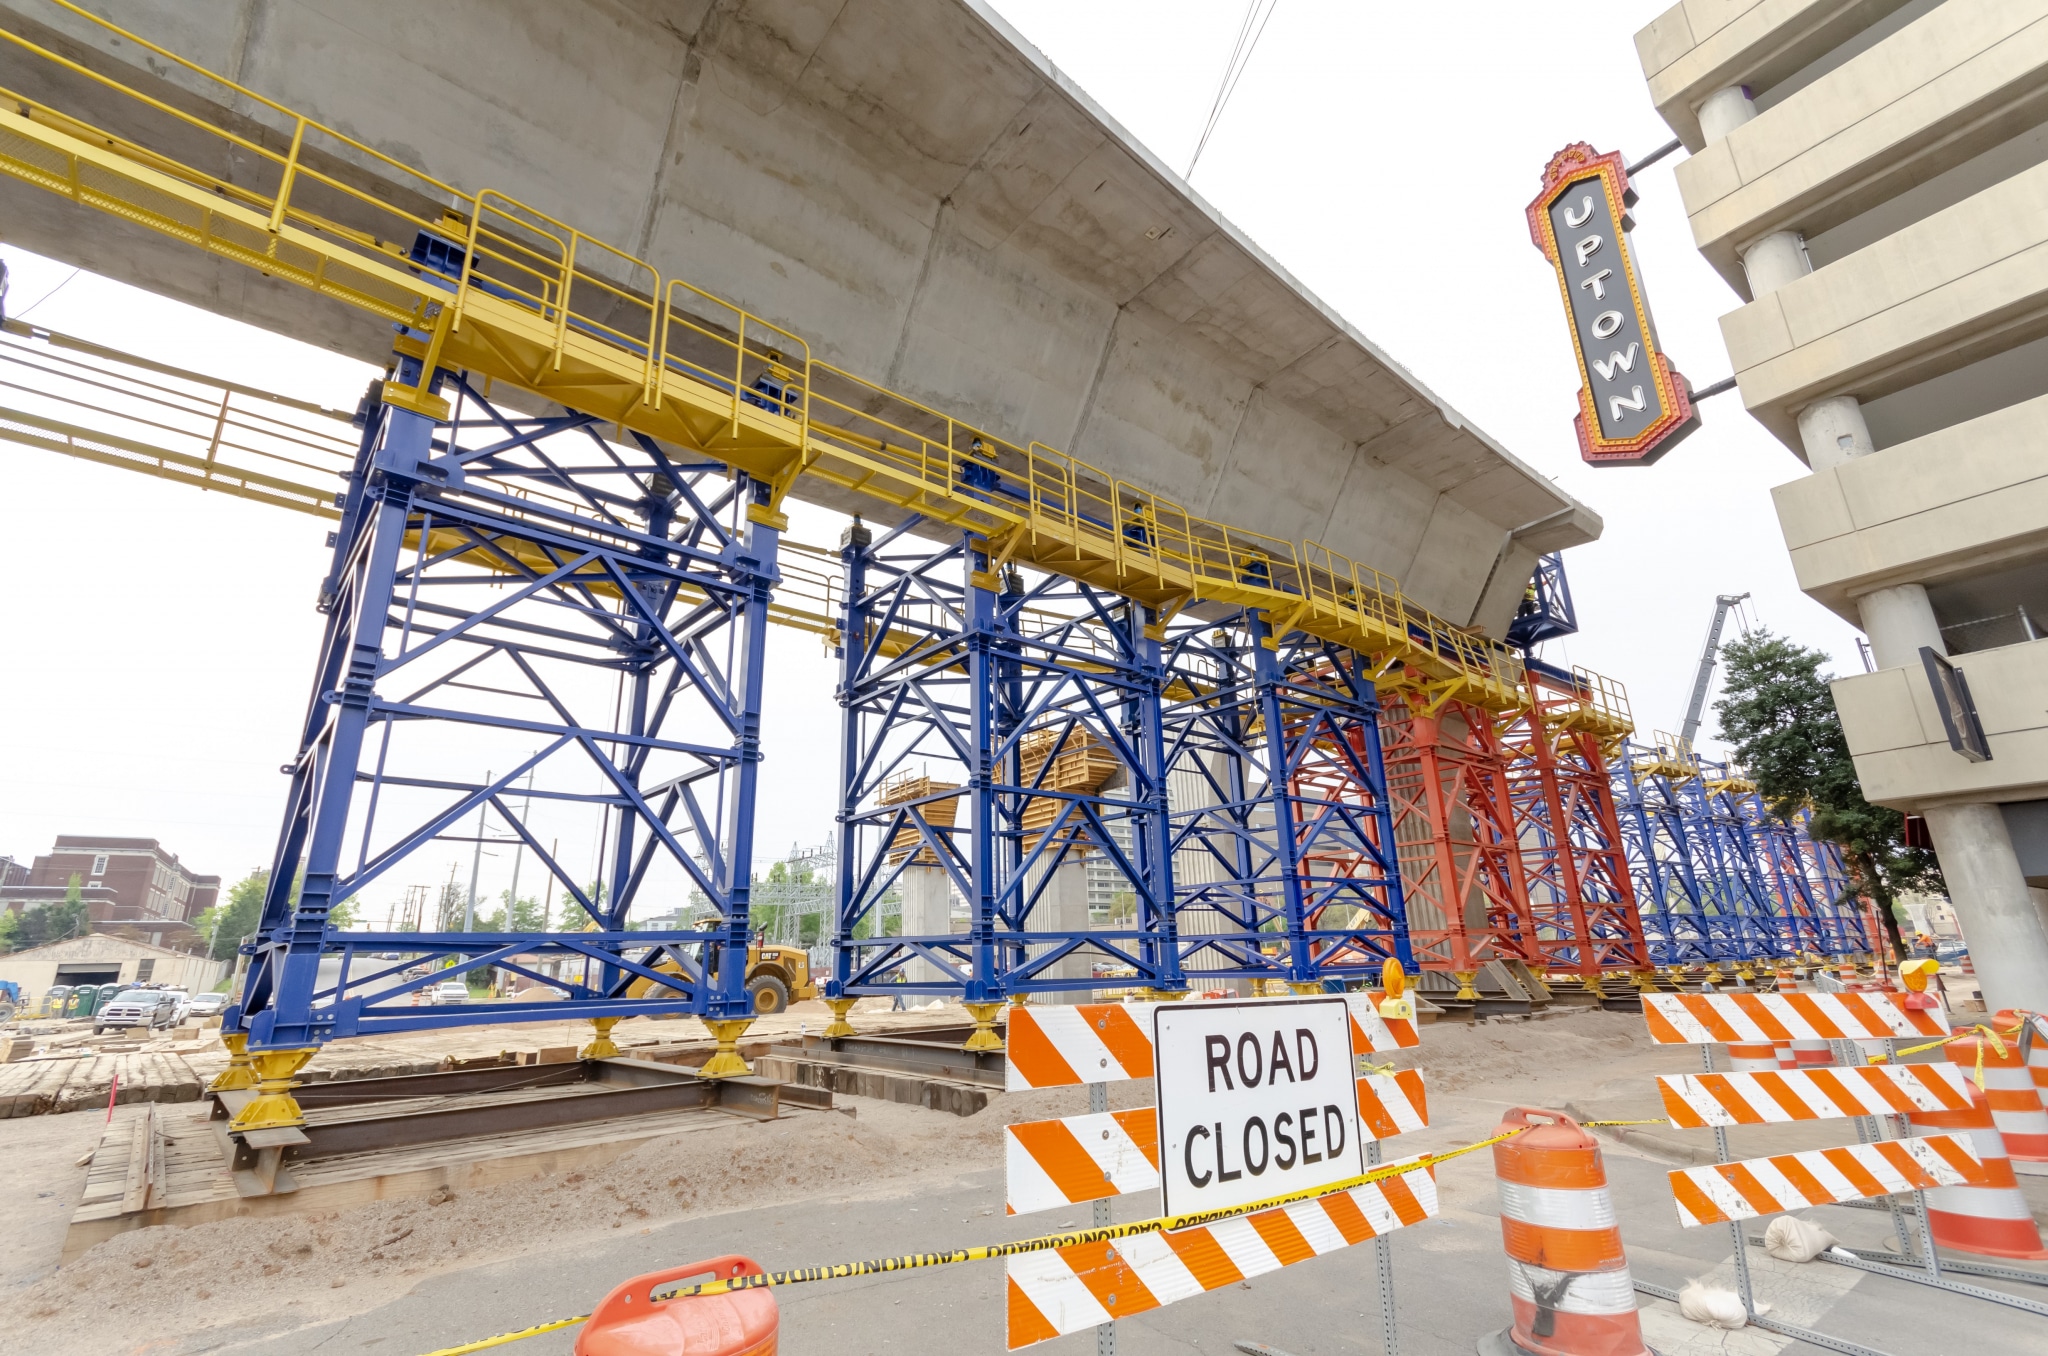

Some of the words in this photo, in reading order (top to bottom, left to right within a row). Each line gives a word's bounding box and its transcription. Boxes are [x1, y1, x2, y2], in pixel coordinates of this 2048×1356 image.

[1564, 196, 1647, 422] UPTOWN
[761, 952, 772, 960] CAT
[1205, 1028, 1319, 1093] ROAD
[1184, 1104, 1346, 1189] CLOSED
